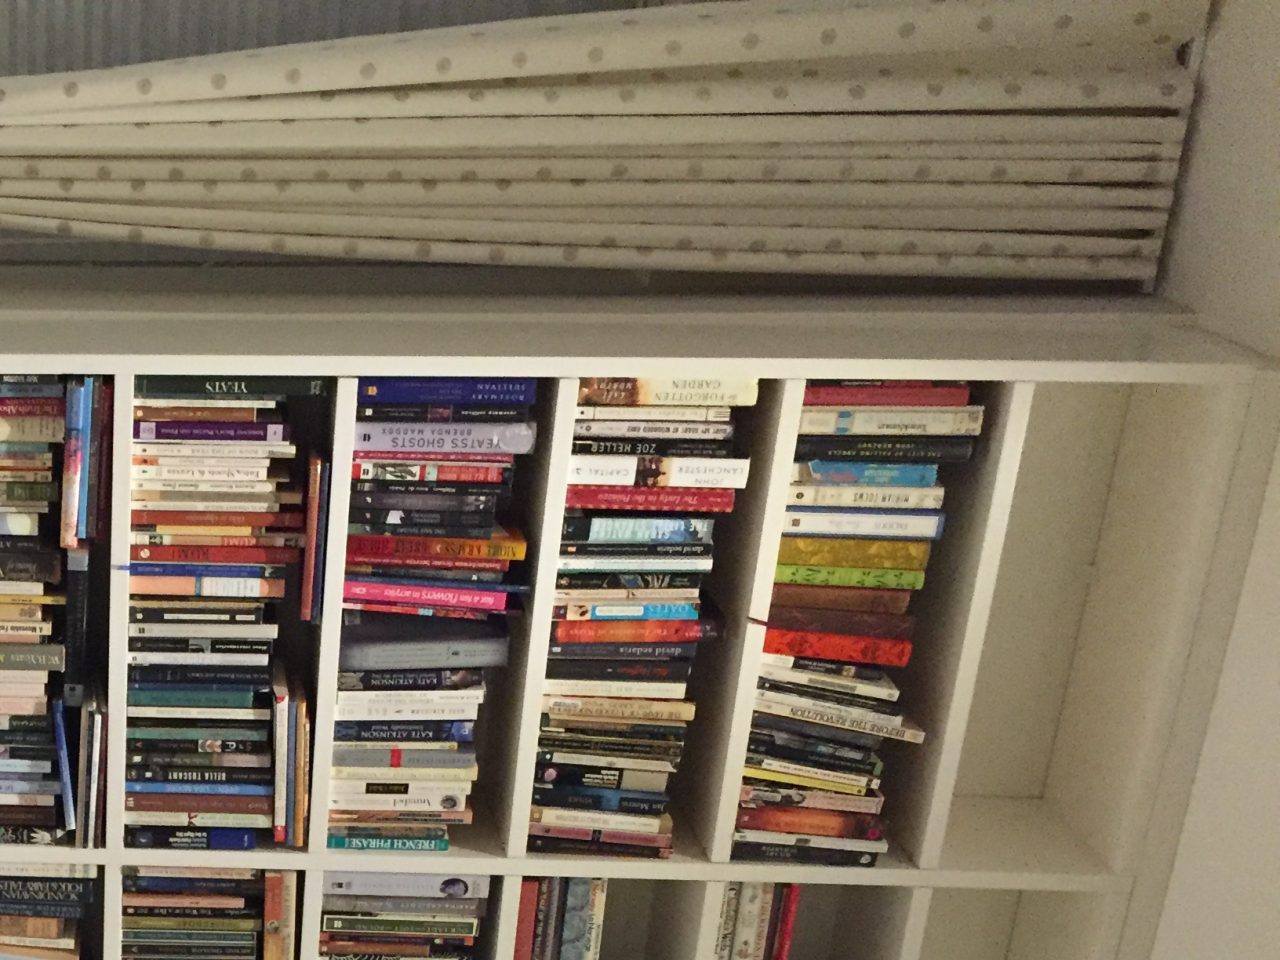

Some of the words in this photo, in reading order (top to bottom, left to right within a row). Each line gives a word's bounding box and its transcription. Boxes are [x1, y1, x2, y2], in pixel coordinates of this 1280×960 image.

[205, 381, 248, 393] YEATS
[476, 383, 526, 391] SULLIVAN
[671, 379, 721, 391] GARDEN
[471, 393, 525, 401] ROSEMARY
[654, 392, 727, 402] FORGOTTEN
[429, 428, 473, 436] BRENDA
[391, 437, 445, 448] GHOSTS
[591, 443, 632, 453] HELLER
[589, 468, 629, 477] CAPITAL
[677, 466, 745, 476] LANCHESTER
[694, 477, 724, 486] JOHN
[682, 545, 704, 554] david
[619, 647, 653, 655] sedaris
[655, 647, 682, 657] david
[789, 707, 847, 729] REVOLUTION
[849, 719, 867, 731] THE
[360, 730, 407, 738] ATKINSON
[409, 730, 433, 738] KATE
[870, 723, 906, 739] BEFORE
[168, 772, 201, 781] TUSCANY
[204, 772, 226, 781] BELLA
[350, 838, 392, 849] PHRASE
[393, 839, 435, 850] FRENCH
[27, 882, 49, 892] FAIRY
[57, 882, 83, 892] FOLK
[1, 890, 79, 901] SCANDINAVIAN
